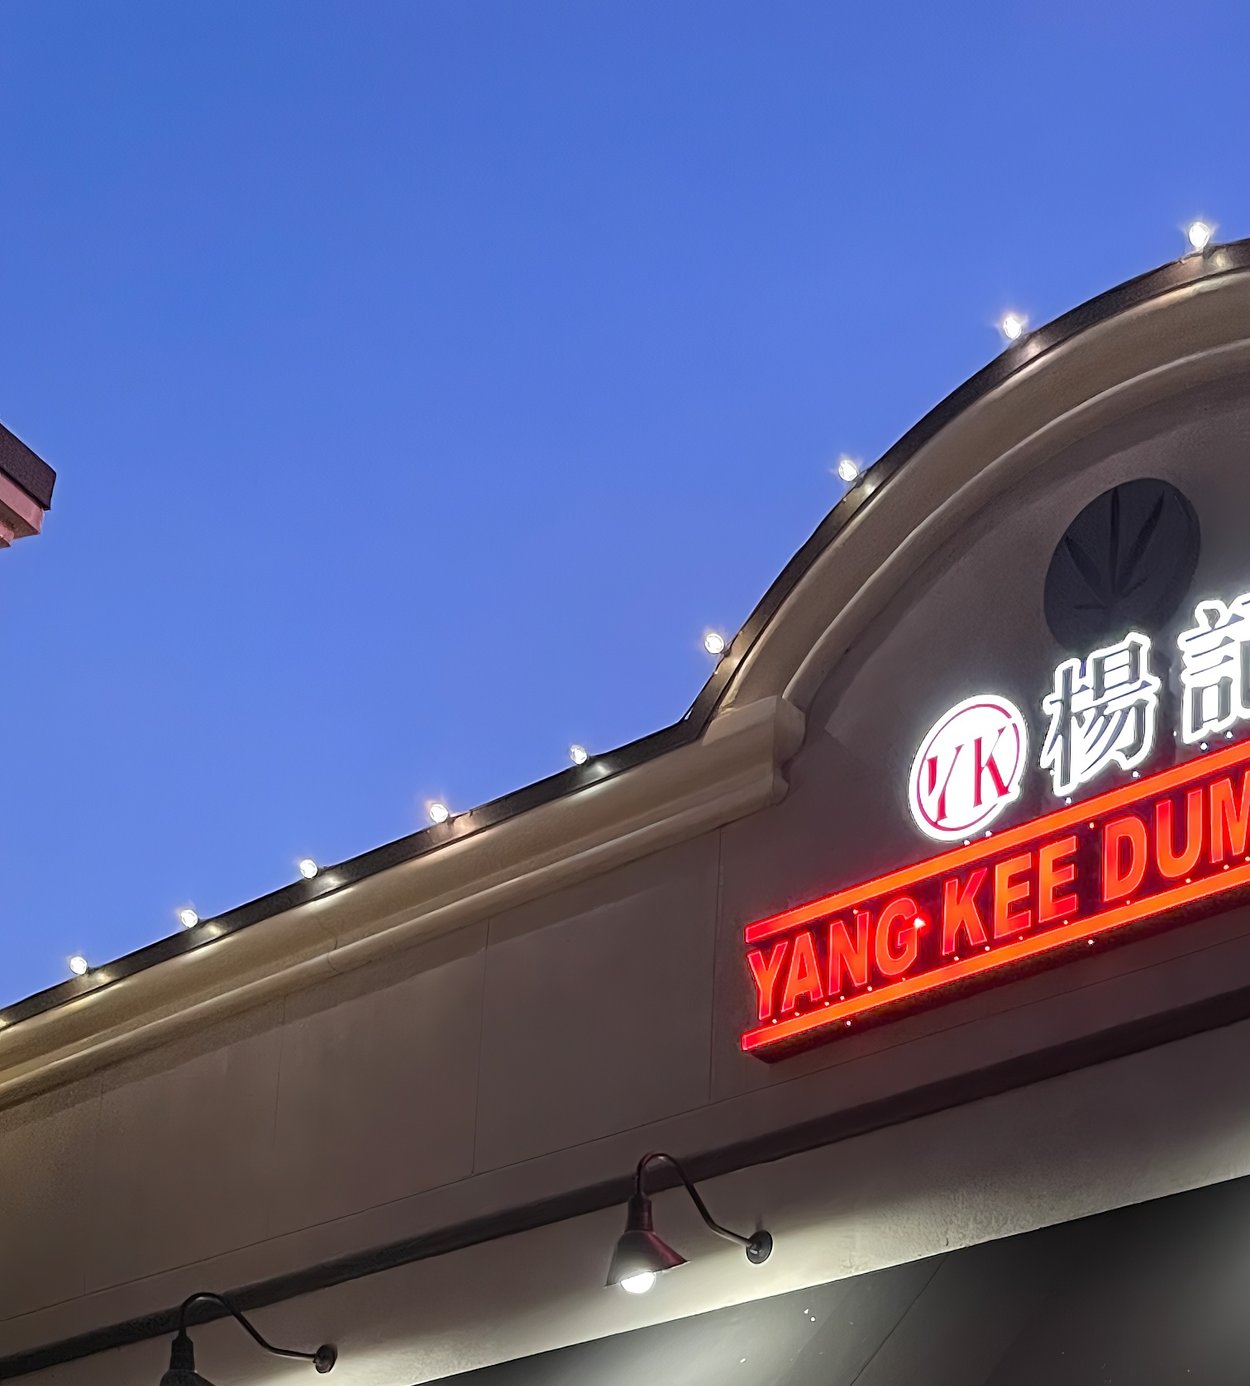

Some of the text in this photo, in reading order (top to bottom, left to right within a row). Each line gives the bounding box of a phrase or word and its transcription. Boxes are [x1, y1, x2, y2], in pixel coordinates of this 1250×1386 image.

[926, 725, 1012, 823] YK
[747, 897, 919, 1021] YANG
[942, 835, 1078, 956] KEE
